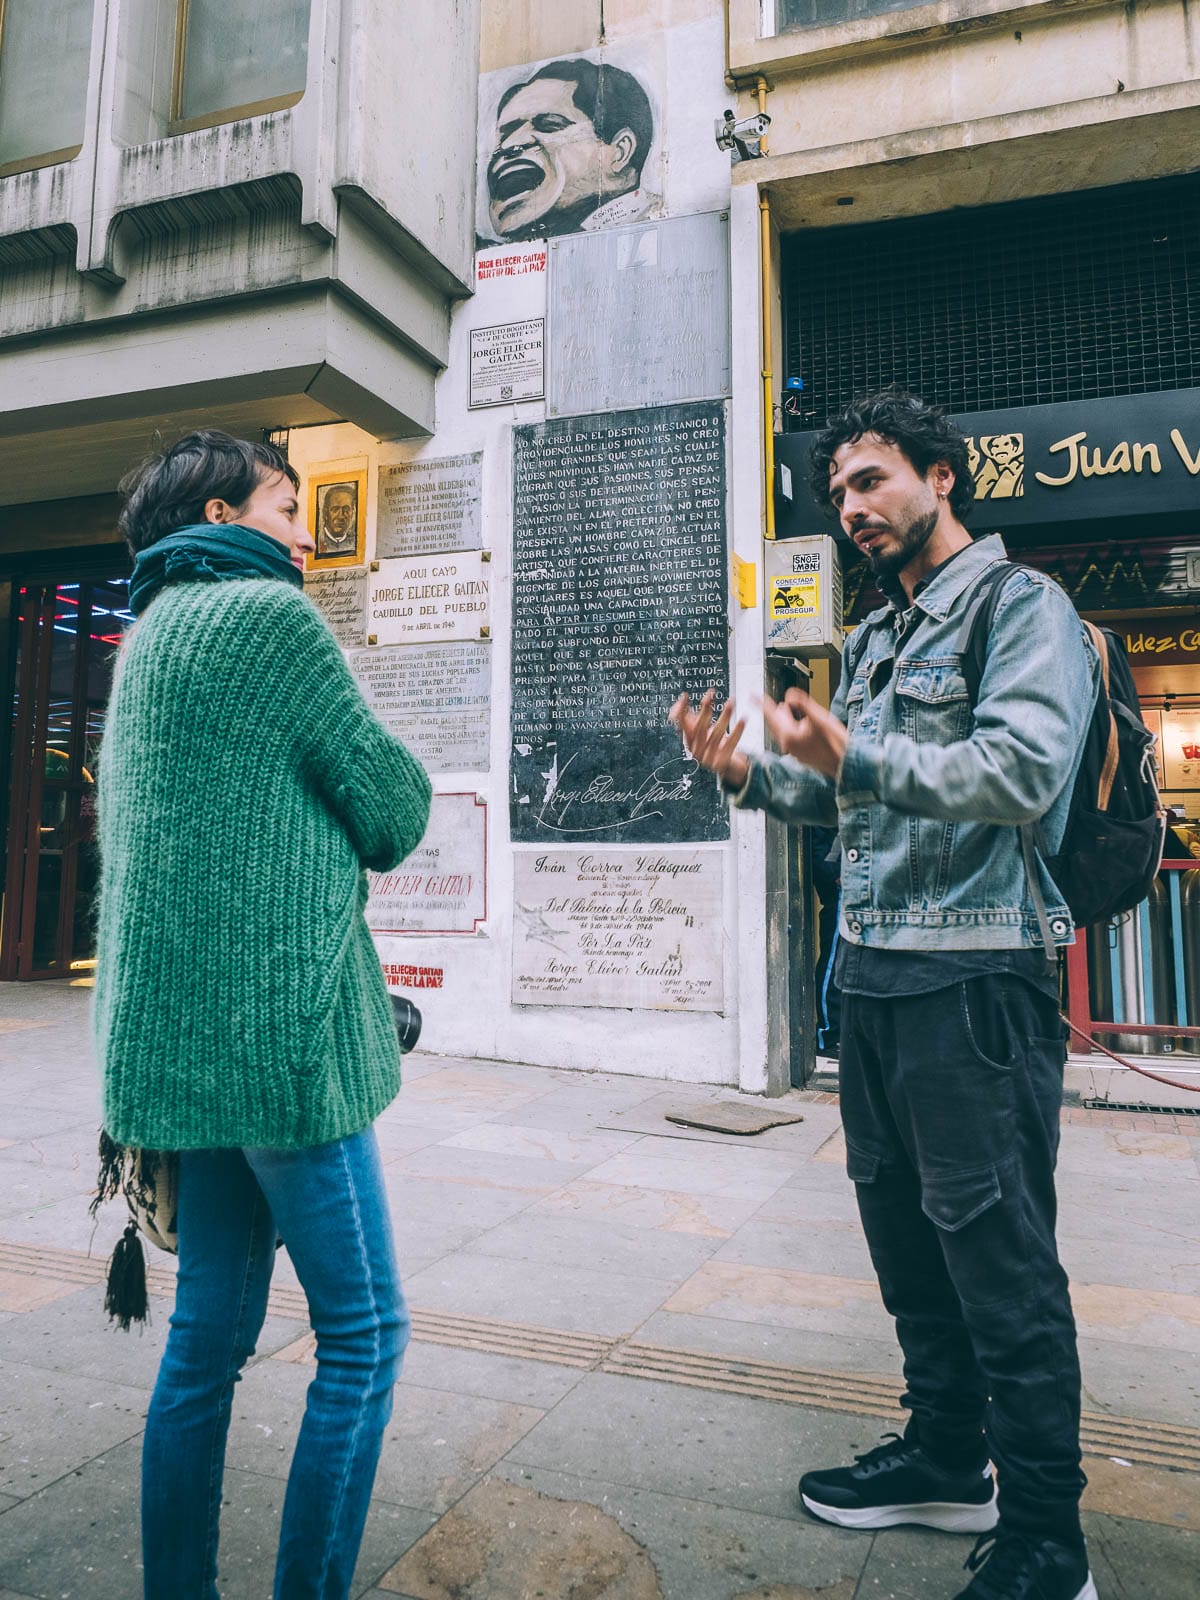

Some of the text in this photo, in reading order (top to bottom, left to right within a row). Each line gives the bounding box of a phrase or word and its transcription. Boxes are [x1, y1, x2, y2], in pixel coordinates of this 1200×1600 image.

[496, 256, 521, 267] ELIECER
[530, 261, 545, 272] PAZ
[473, 323, 542, 338] INSTITUTO BOGOTANO
[473, 341, 542, 358] JORGE ELIECER
[489, 352, 525, 364] GAITAN
[517, 440, 528, 449] YO
[533, 438, 544, 447] NO
[548, 436, 571, 445] CREO
[576, 433, 588, 442] EN
[608, 426, 649, 438] DESTINO
[654, 418, 707, 432] MESIANICO
[1035, 431, 1162, 486] Juan
[517, 499, 720, 526] SAMIENTO DEL ALMA COLECTIVA NO CREO
[517, 511, 720, 538] QUE EXISTA NI EN EL PRETERITO NI EN EL
[517, 522, 720, 548] PRESENTE UN HOMBRE CAPAZ DE ACTUAR
[517, 534, 720, 559] SOBRE LAS MASAS COMO EL CINCEL DEL
[403, 566, 457, 579] AQUI CAYO
[517, 569, 722, 593] RIGENTE DE LOS GRANDES MOVIMIENTOS
[372, 587, 404, 602] JORGE
[408, 584, 450, 599] ELIECER
[454, 581, 489, 595] GAITAN
[517, 592, 575, 604] POPULARES
[597, 588, 630, 598] AQUEL
[634, 586, 653, 596] QUE
[658, 583, 692, 593] POSEE
[698, 581, 720, 590] UNA
[373, 608, 413, 618] CAUDILLO
[420, 605, 438, 616] DEL
[445, 601, 486, 613] PUEBLO
[517, 593, 722, 616] SENSIBILIDAD UNA CAPACIDAD PLASTICA
[516, 618, 540, 627] PARA
[544, 615, 580, 625] CAPTAR
[593, 611, 635, 622] RESUMIR
[639, 610, 651, 618] EN
[656, 608, 668, 617] UN
[672, 604, 722, 616] MOMENTO
[442, 621, 455, 630] 1948
[515, 617, 723, 638] DADO EL IMPULSO QUE LABORA EN EL
[1126, 630, 1200, 653] ldez Ca
[514, 735, 544, 743] TINOS
[534, 856, 567, 873] Iván
[577, 856, 623, 873] Correa
[370, 875, 422, 895] LIECER
[544, 898, 567, 913] Del
[569, 899, 613, 914] Palacio
[616, 899, 629, 914] de
[633, 899, 643, 914] la
[577, 932, 598, 948] Por
[604, 932, 622, 948] La
[391, 965, 417, 975] ELIECER
[419, 967, 443, 976] GAITAN
[544, 958, 577, 976] Jorge
[387, 975, 443, 988] TIR DE LA PAZ
